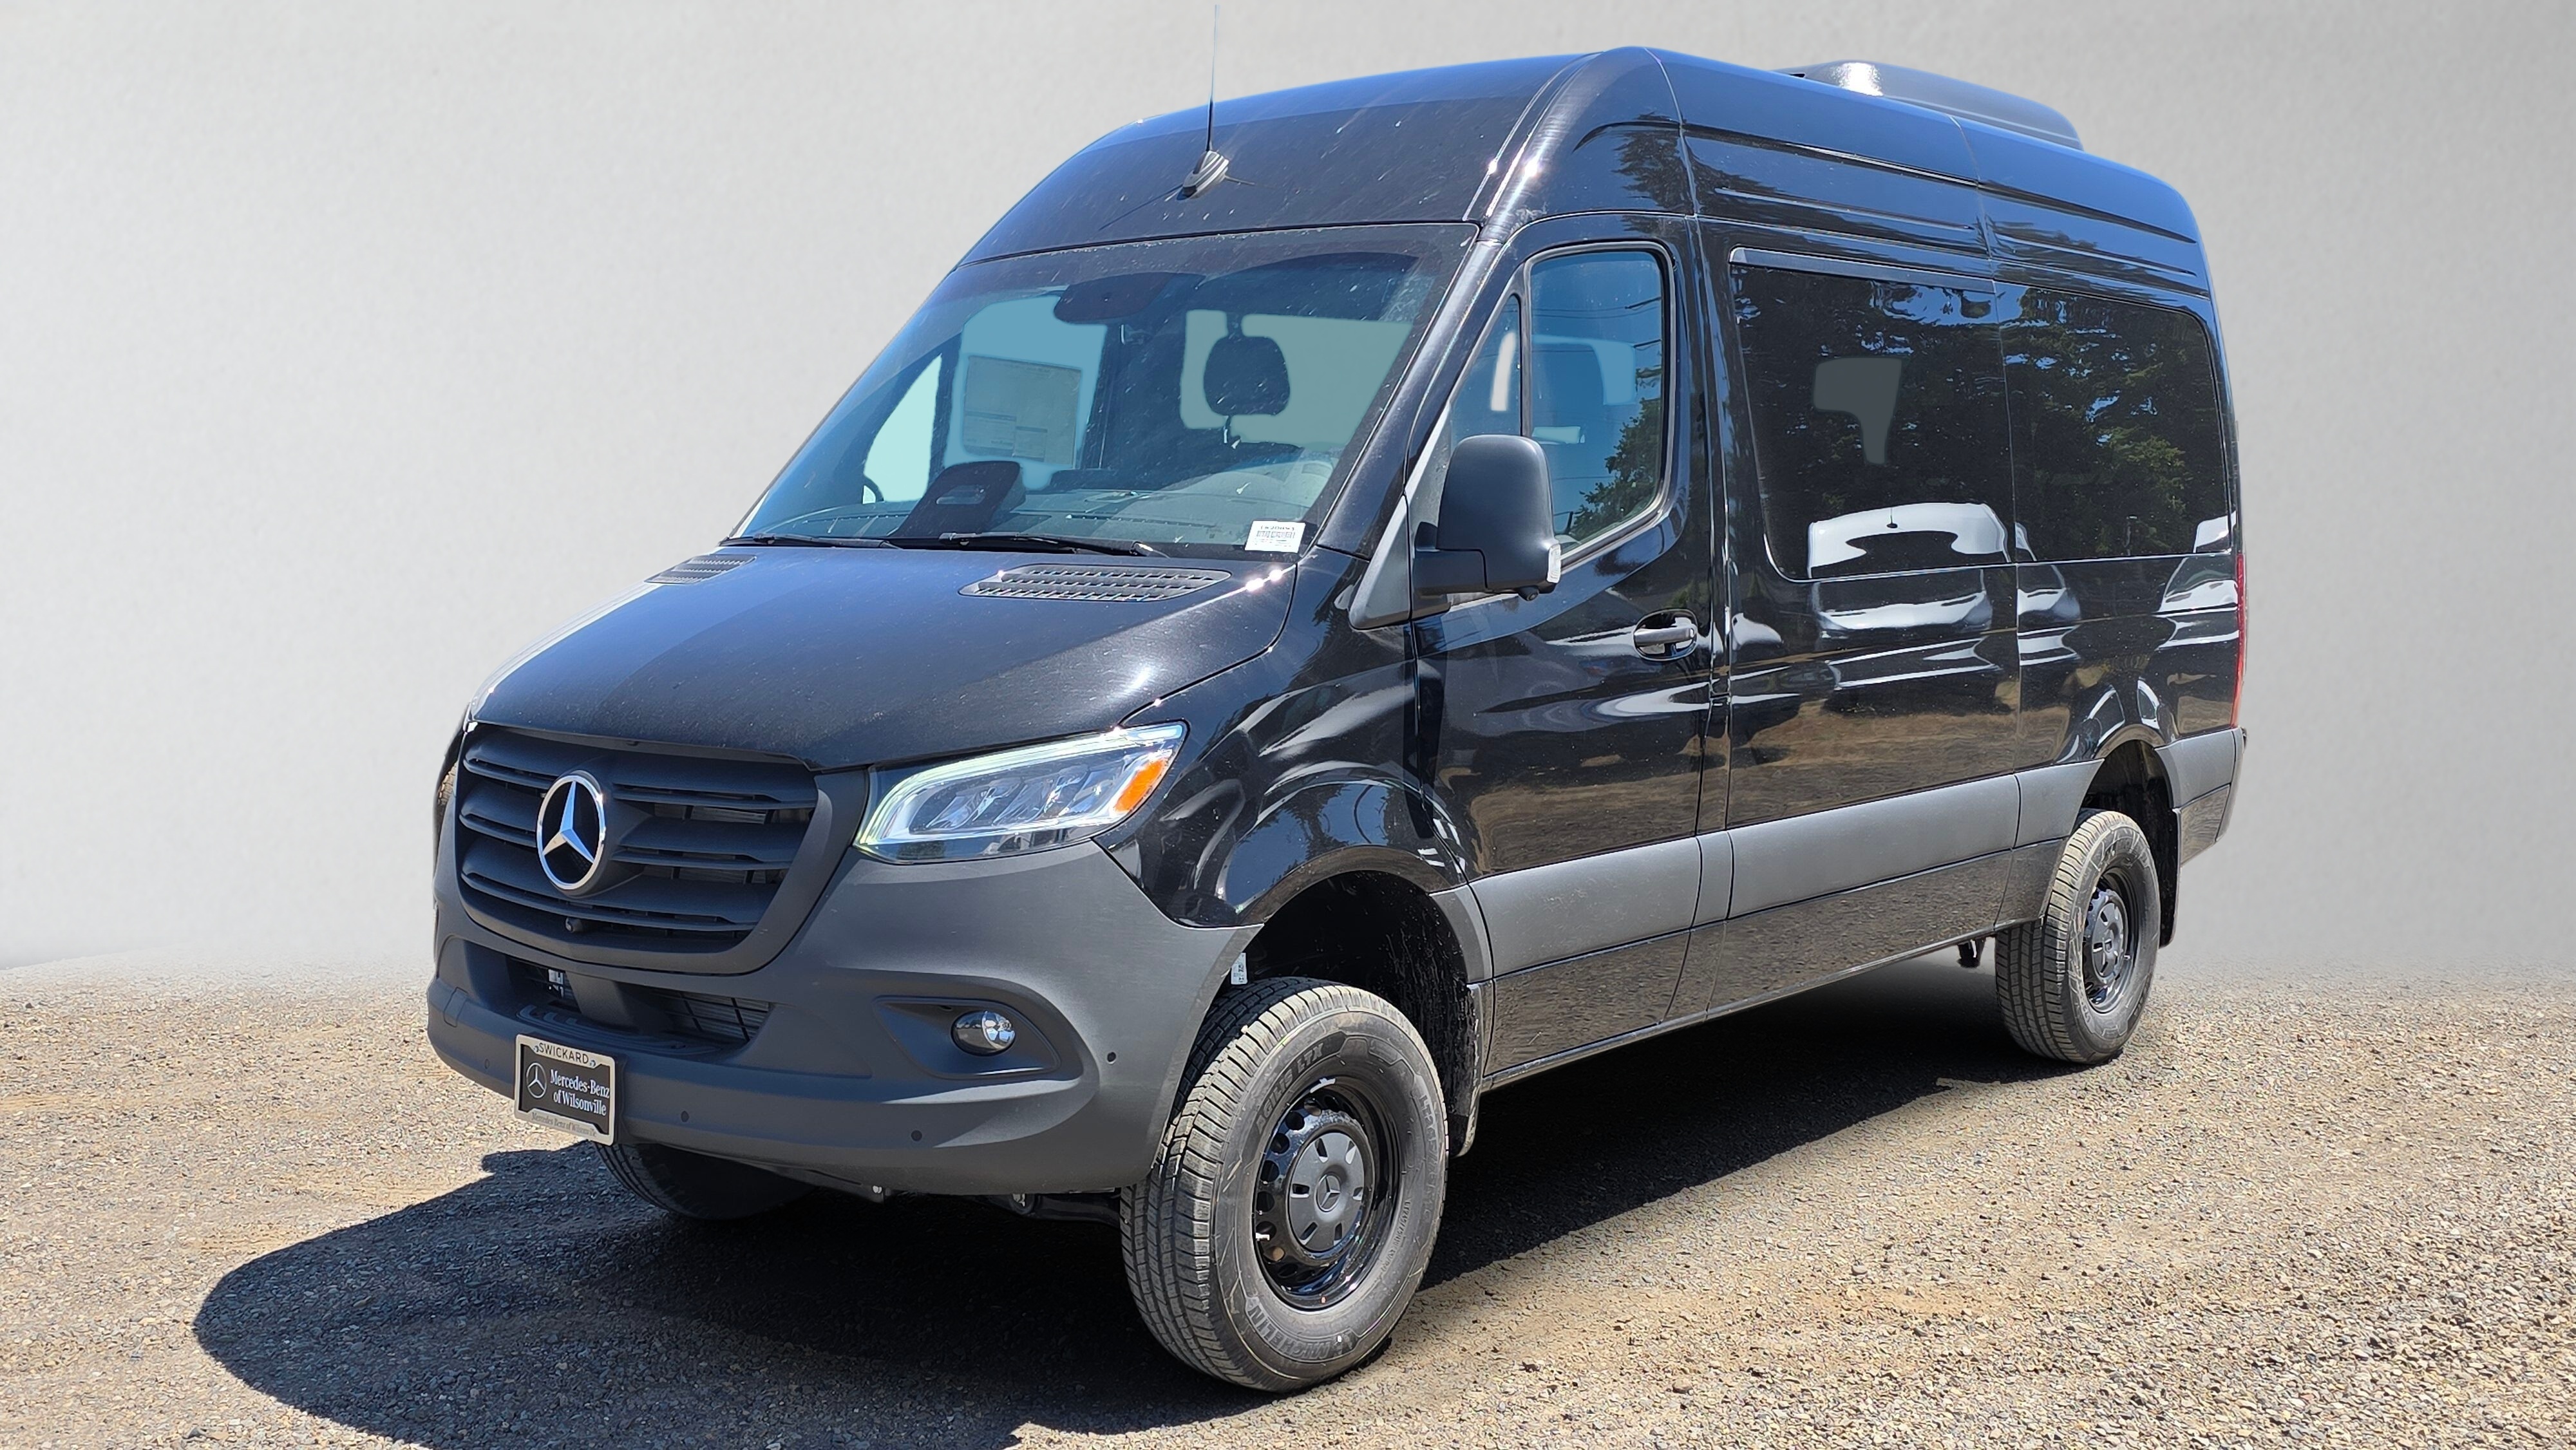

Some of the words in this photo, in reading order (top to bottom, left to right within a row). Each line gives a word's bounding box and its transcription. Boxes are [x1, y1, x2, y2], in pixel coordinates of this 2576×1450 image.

[538, 1042, 589, 1064] SWICKARD
[550, 1069, 611, 1099] Mercedes-Benz
[1256, 1068, 1293, 1135] AGILIS
[1297, 1042, 1323, 1074] LTX
[553, 1089, 562, 1104] of
[562, 1091, 607, 1116] Wilsonville
[1247, 1304, 1331, 1359] MICHELIN
